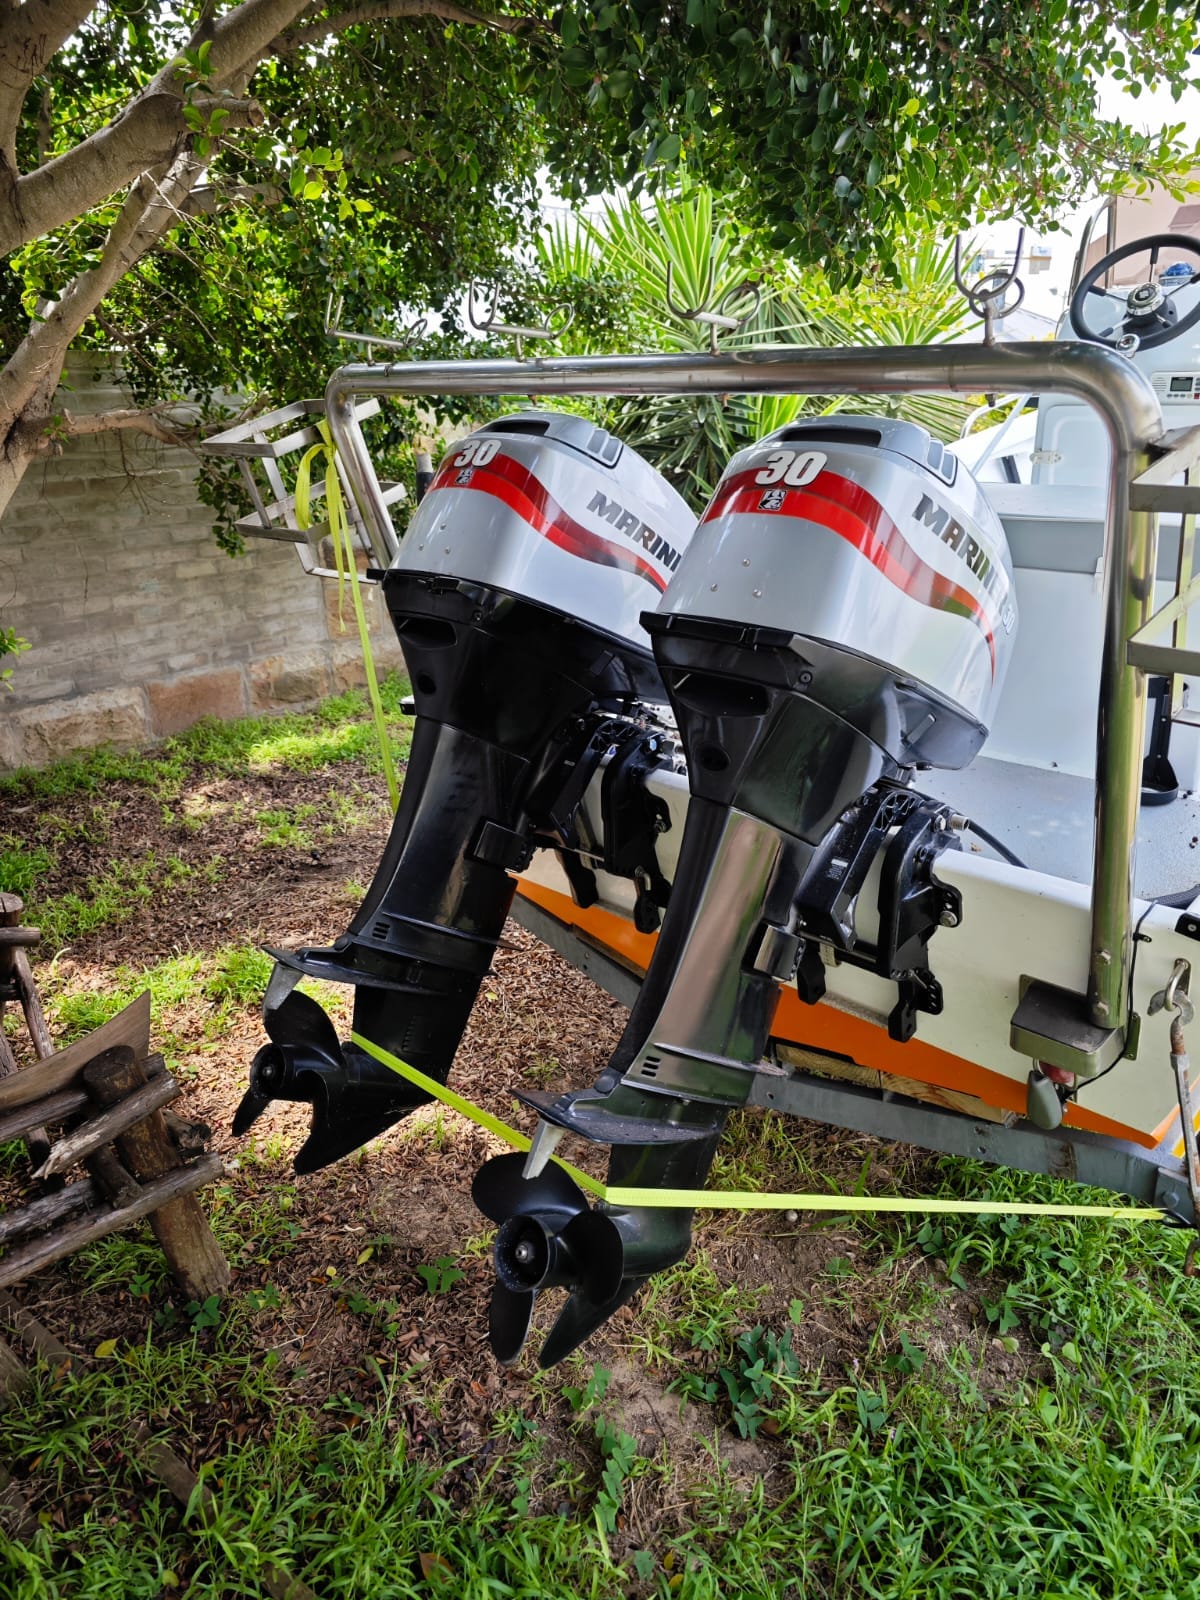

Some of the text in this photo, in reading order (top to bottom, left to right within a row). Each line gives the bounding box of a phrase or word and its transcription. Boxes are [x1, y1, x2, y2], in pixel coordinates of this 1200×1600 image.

[453, 439, 502, 467] 30
[754, 450, 828, 487] 30
[911, 492, 1008, 617] MARIN
